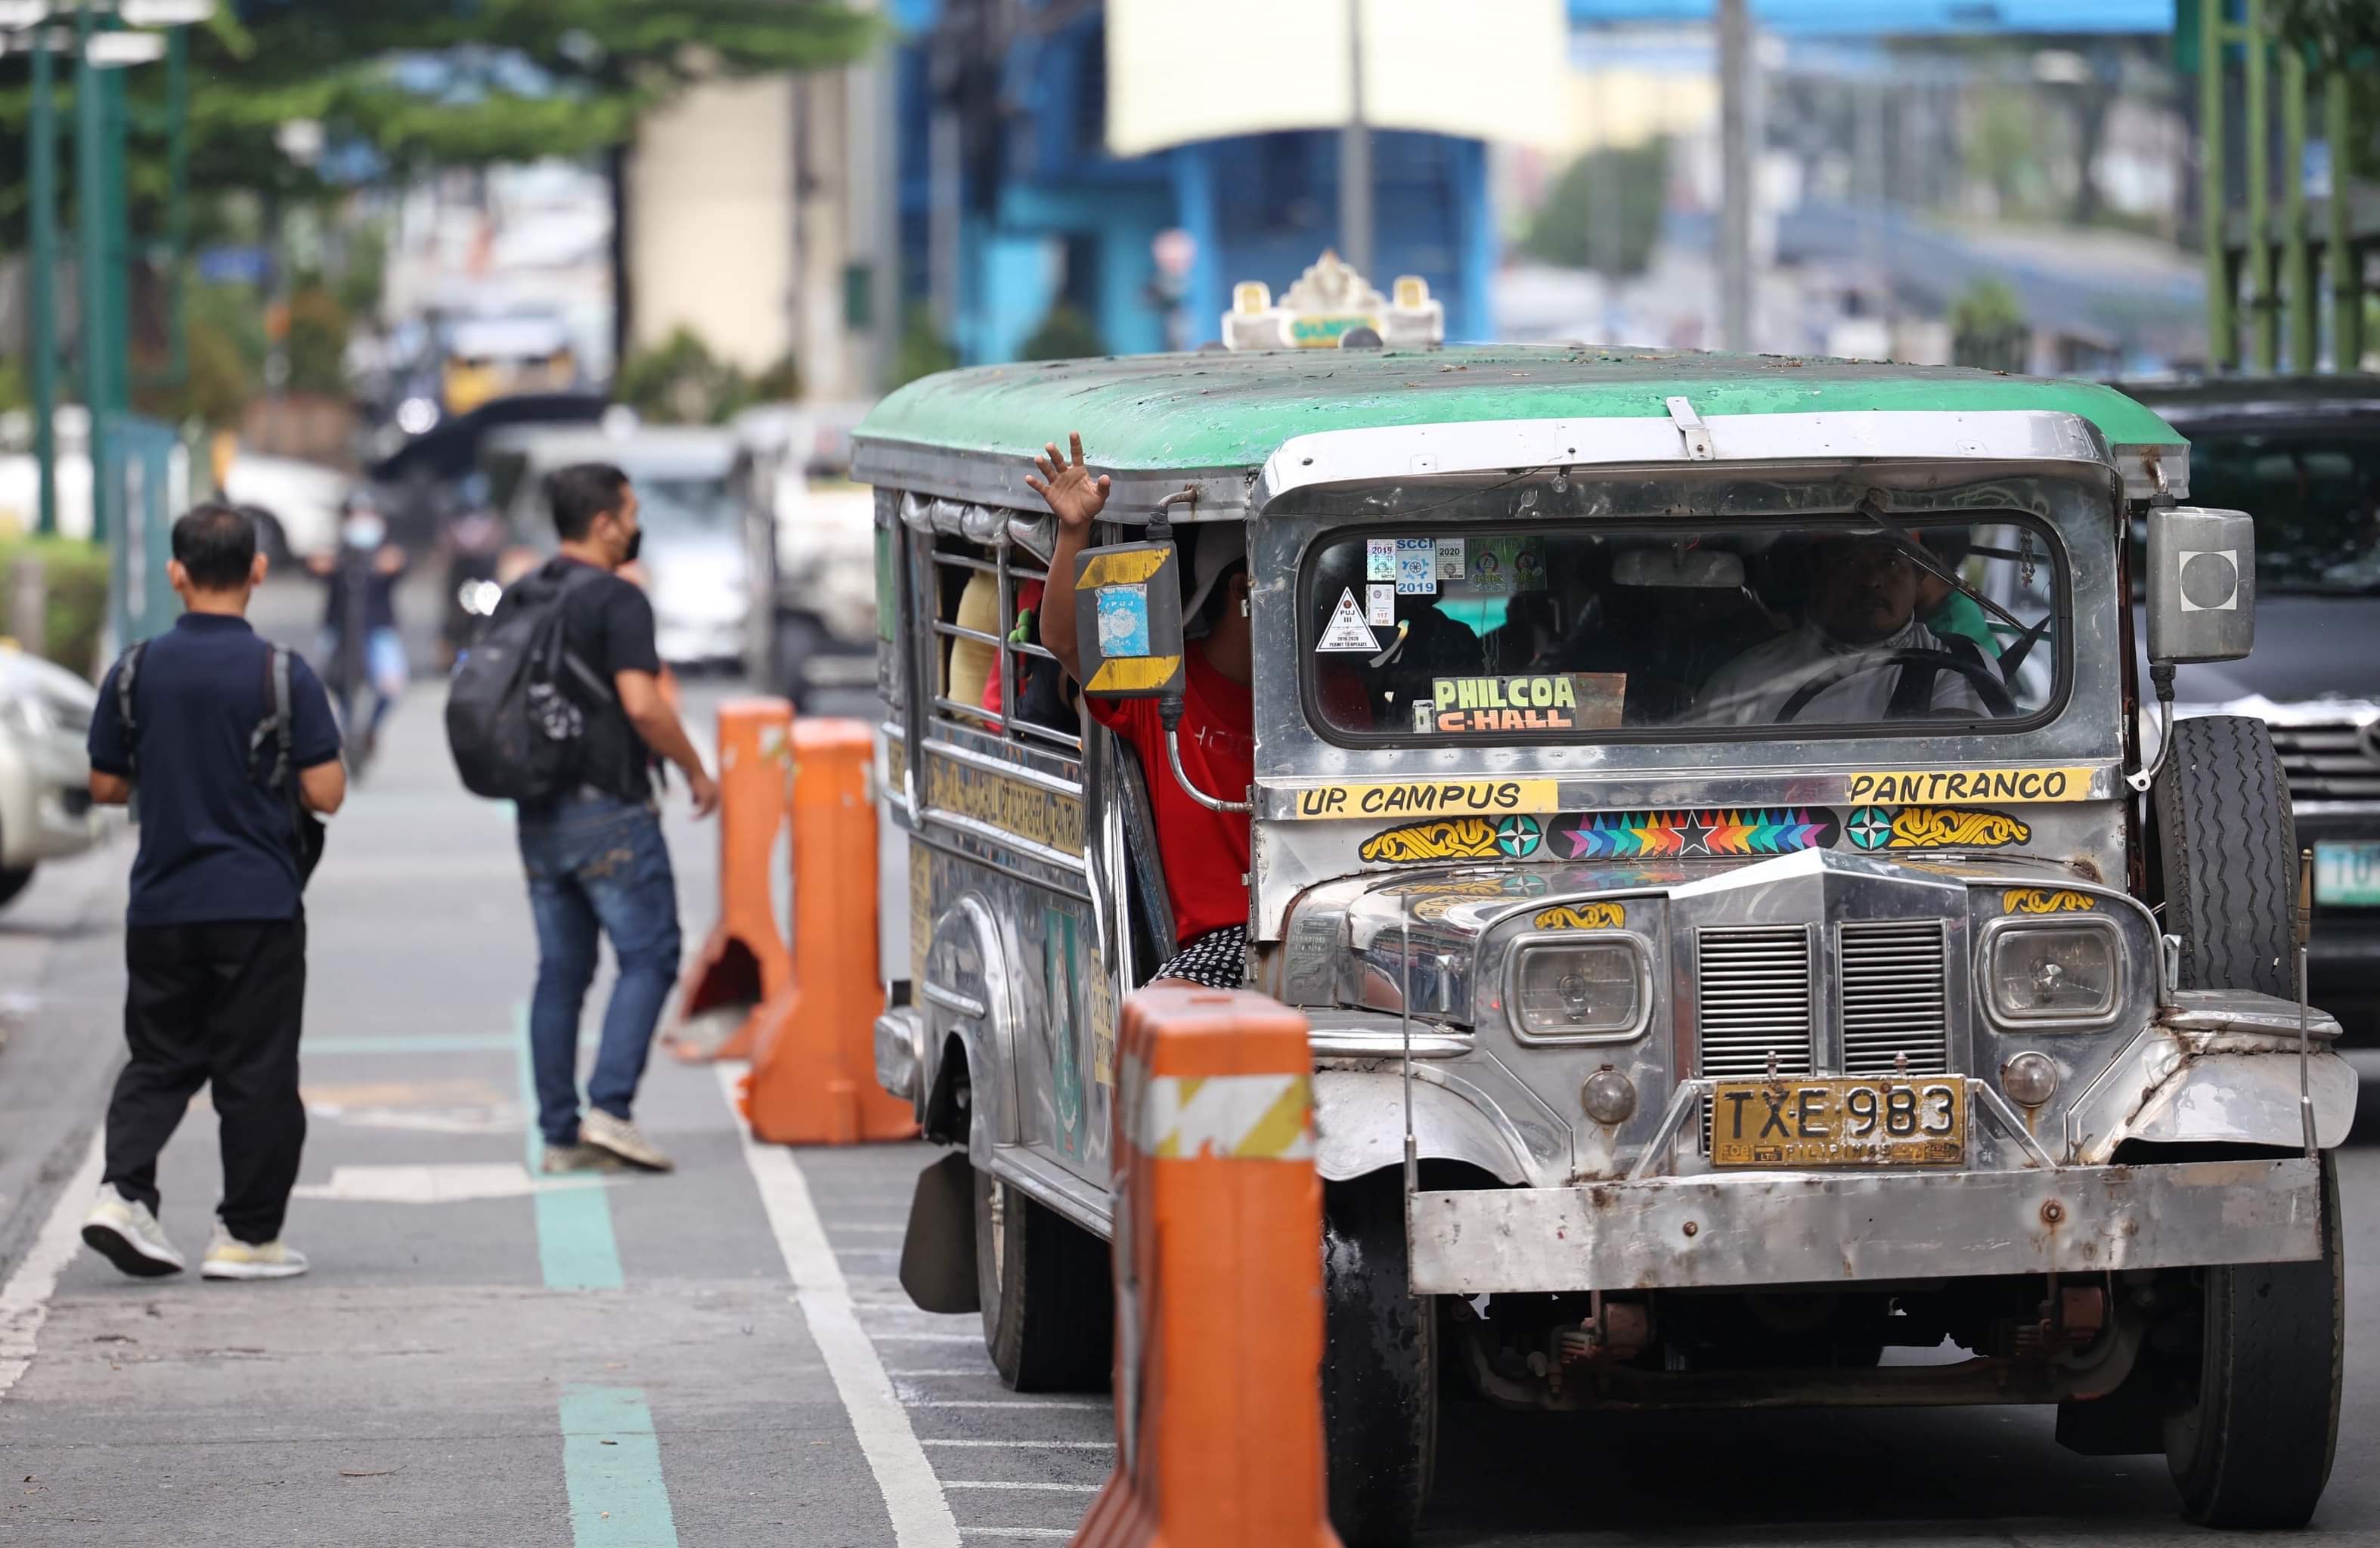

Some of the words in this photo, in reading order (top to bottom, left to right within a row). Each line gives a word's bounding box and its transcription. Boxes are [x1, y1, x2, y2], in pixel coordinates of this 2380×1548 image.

[1397, 539, 1433, 549] SCCI
[1398, 583, 1433, 593] 2019
[1435, 677, 1576, 711] PHILCOA
[1362, 783, 1520, 813] CAMPUS
[1850, 772, 2066, 802] PANTRANCO
[1725, 1088, 1830, 1138] TXE
[1846, 1085, 1954, 1136] 983
